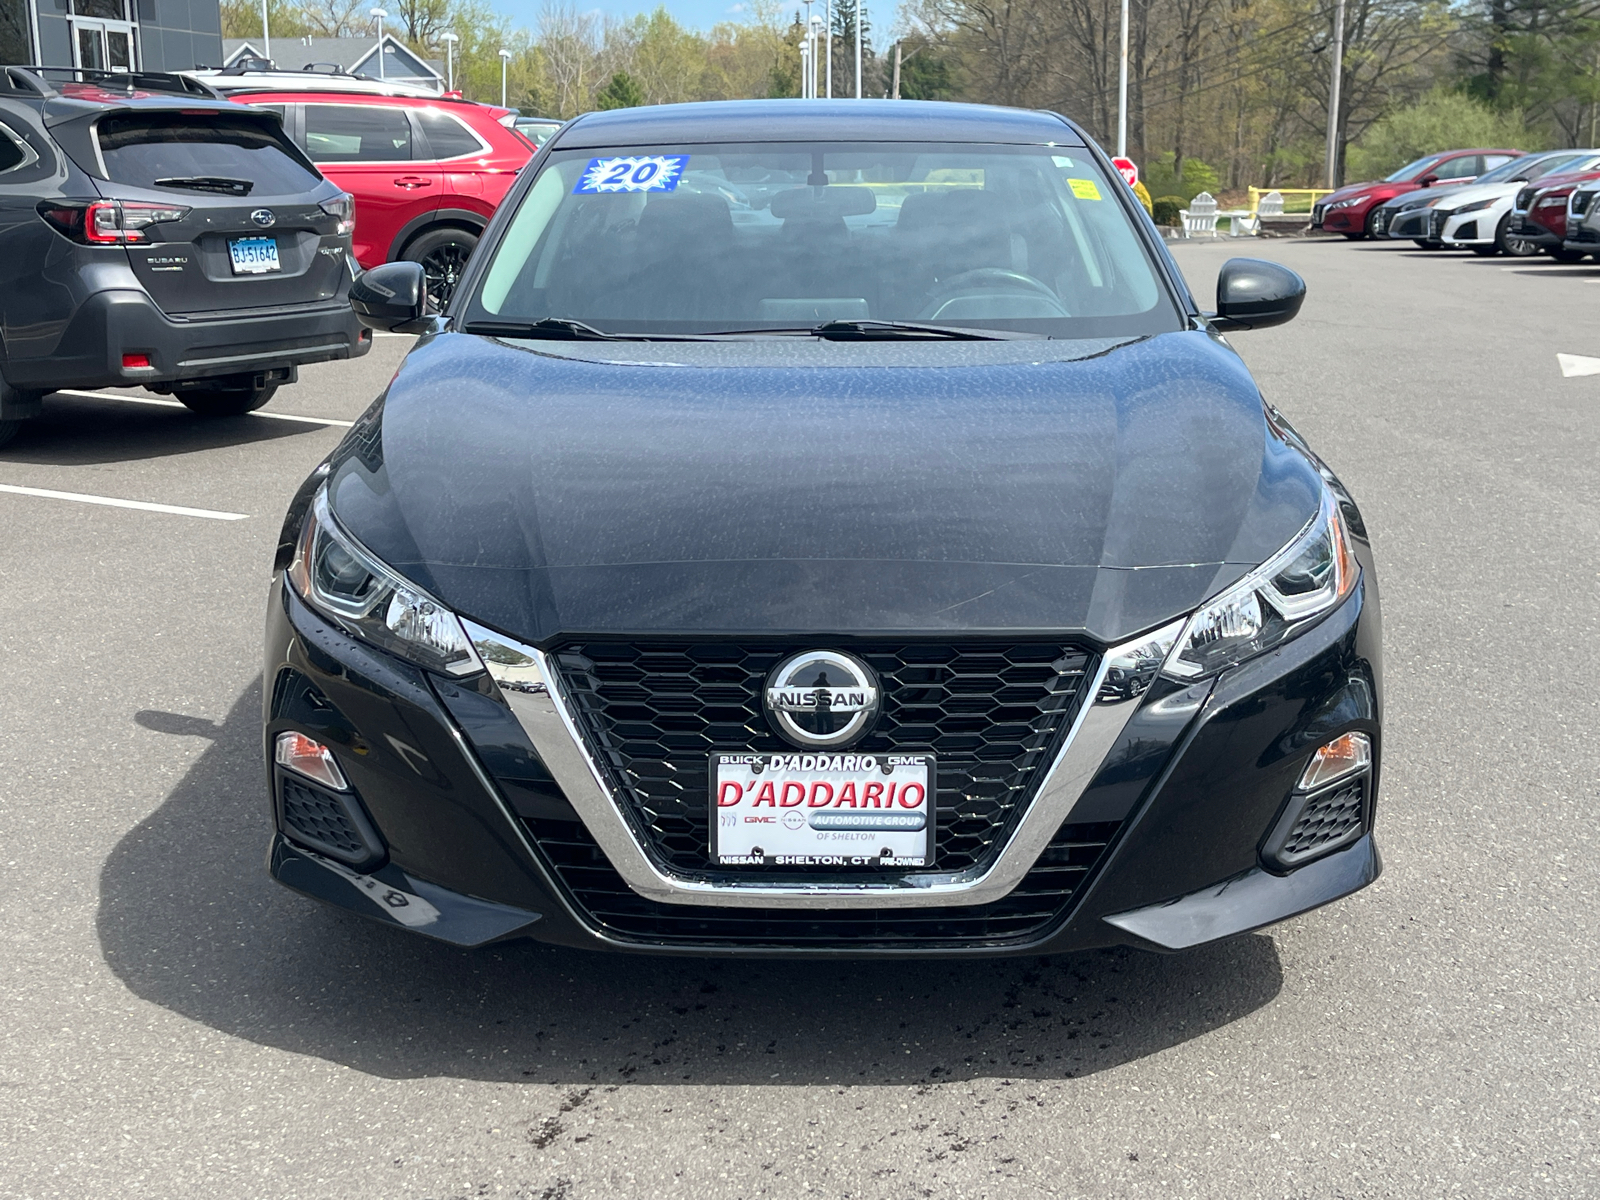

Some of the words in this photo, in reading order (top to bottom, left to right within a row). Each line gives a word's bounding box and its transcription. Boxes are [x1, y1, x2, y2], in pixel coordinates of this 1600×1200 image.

[600, 162, 658, 185] 20
[779, 692, 864, 706] NISSAN
[719, 755, 763, 764] BUICK
[769, 755, 877, 772] D'ADDARIO
[888, 756, 926, 765] GMC
[717, 780, 926, 809] D'ADDARIO
[814, 815, 882, 826] AUTOMOTIVE
[884, 816, 922, 827] GROUP
[816, 832, 830, 841] OF
[832, 832, 876, 841] SHELTON
[719, 855, 764, 865] NISSAN
[775, 855, 848, 866] SHELTON,
[850, 856, 872, 865] CT
[879, 857, 925, 866] PRE-OWNED
